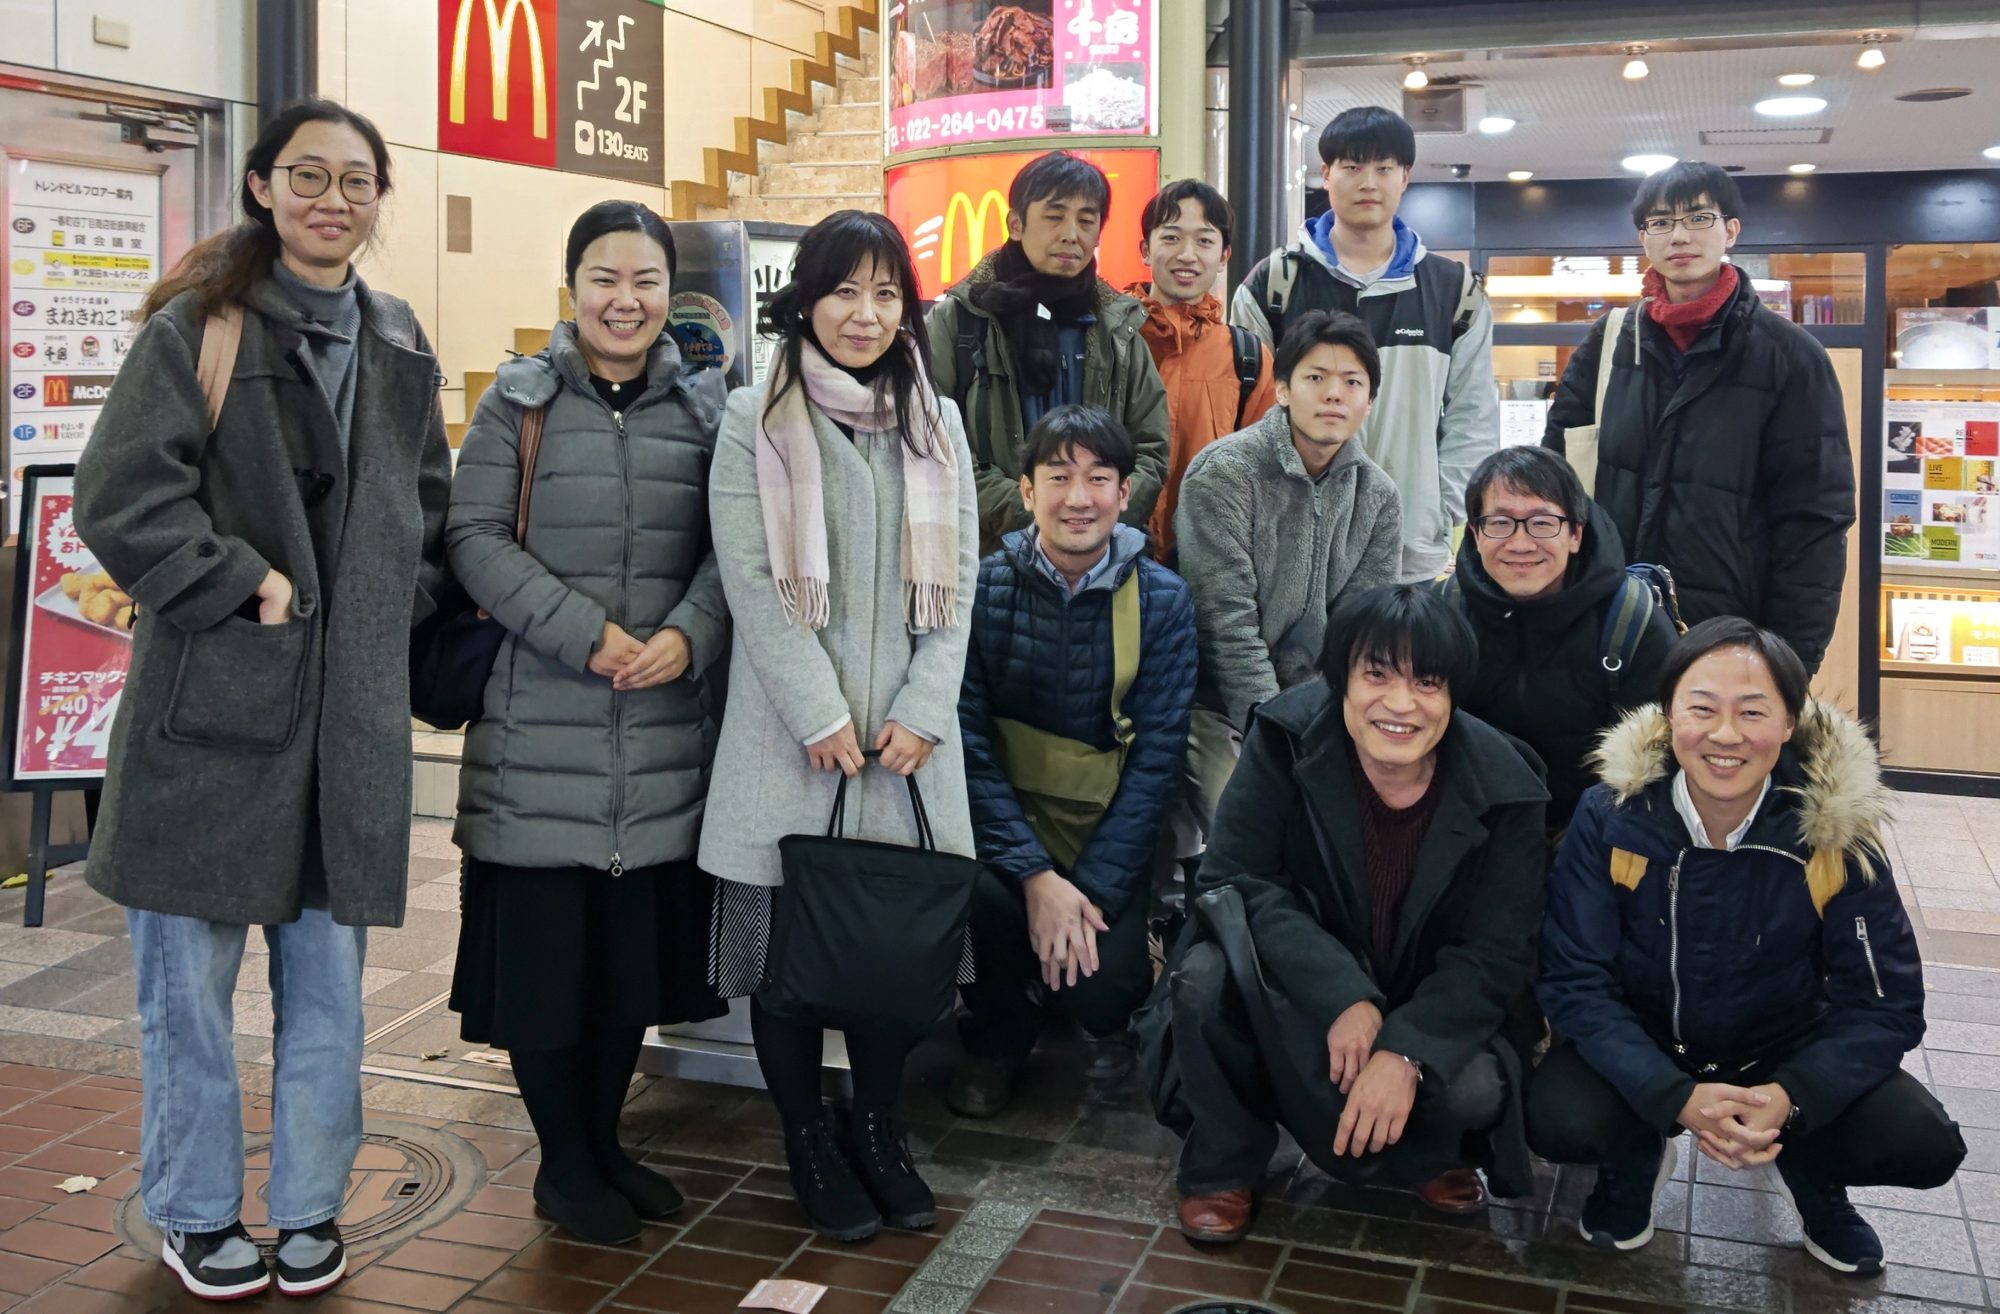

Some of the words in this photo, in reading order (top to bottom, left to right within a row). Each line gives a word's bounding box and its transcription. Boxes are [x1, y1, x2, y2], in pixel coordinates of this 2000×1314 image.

[614, 76, 647, 124] 2F
[906, 105, 1044, 143] 022-264-0475
[597, 129, 623, 157] 130
[623, 144, 649, 162] SEATS
[46, 307, 118, 326] まねきねこ
[17, 386, 33, 398] 2F
[18, 426, 33, 437] 1F
[40, 695, 88, 715] ¥740
